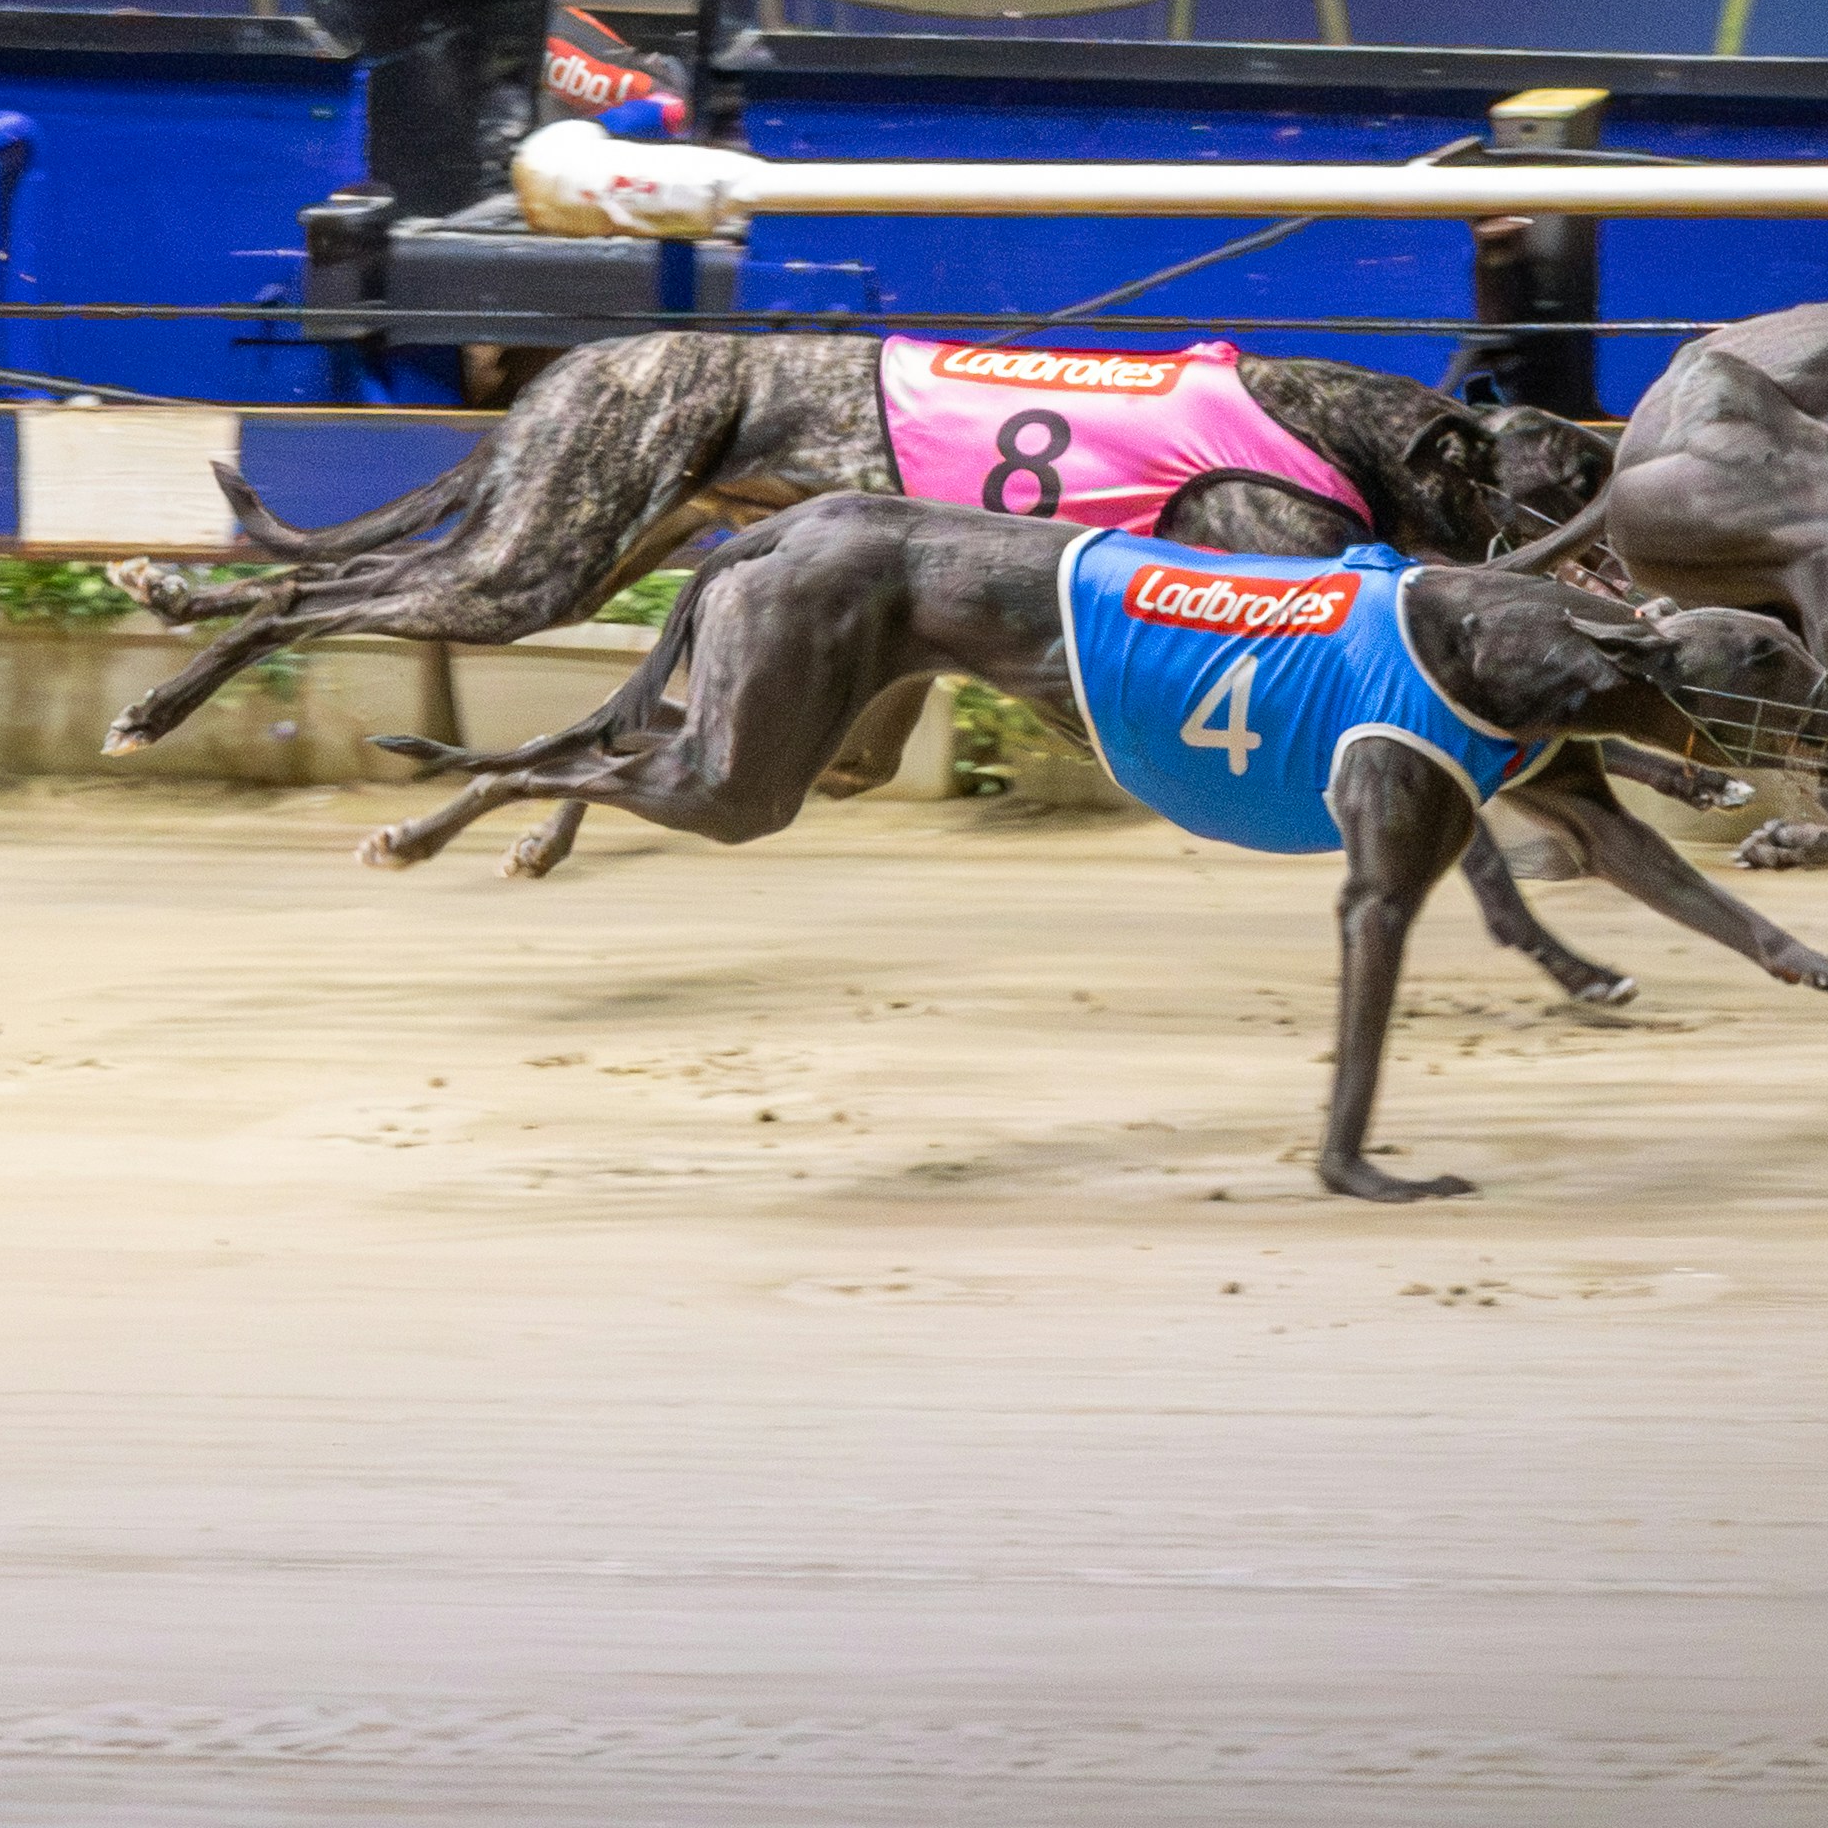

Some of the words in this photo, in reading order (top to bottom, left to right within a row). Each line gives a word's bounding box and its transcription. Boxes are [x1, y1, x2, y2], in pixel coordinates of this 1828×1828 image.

[943, 348, 1176, 387] Ladbrokes
[982, 408, 1072, 518] 8
[1135, 569, 1346, 627] Ladbrokes
[1179, 654, 1263, 777] 4
